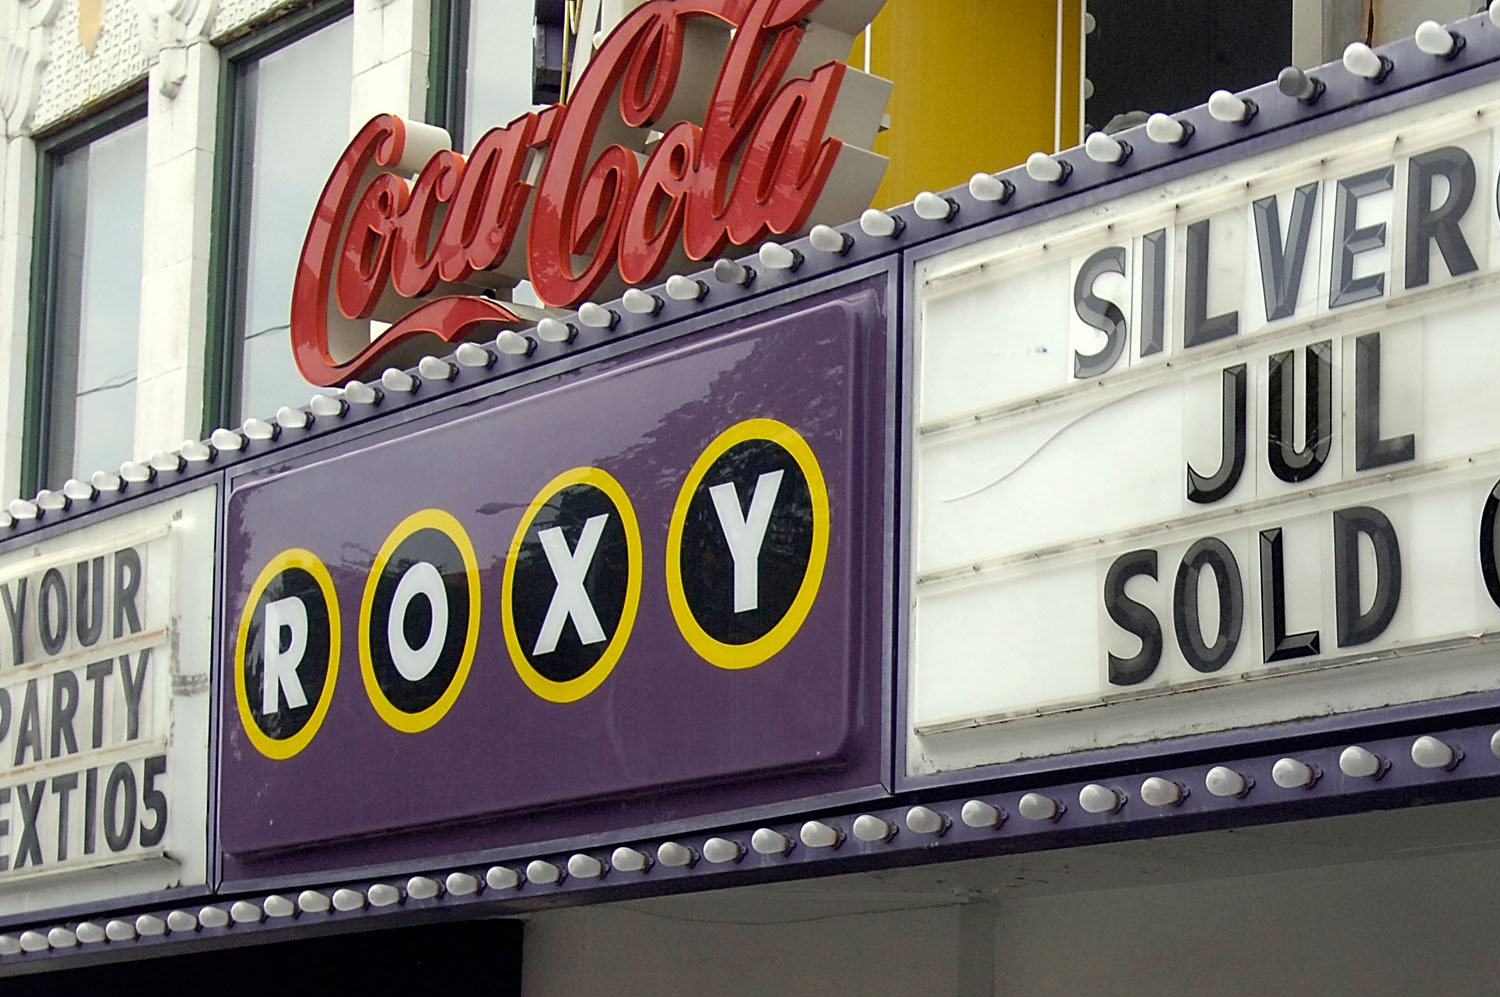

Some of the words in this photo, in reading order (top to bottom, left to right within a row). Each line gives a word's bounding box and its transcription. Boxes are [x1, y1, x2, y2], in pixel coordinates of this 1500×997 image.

[291, 0, 846, 387] Coca-Cola
[1185, 331, 1416, 505] JUL
[0, 547, 143, 666] YOUR
[261, 469, 785, 716] ROXY
[1104, 503, 1402, 688] SOLD
